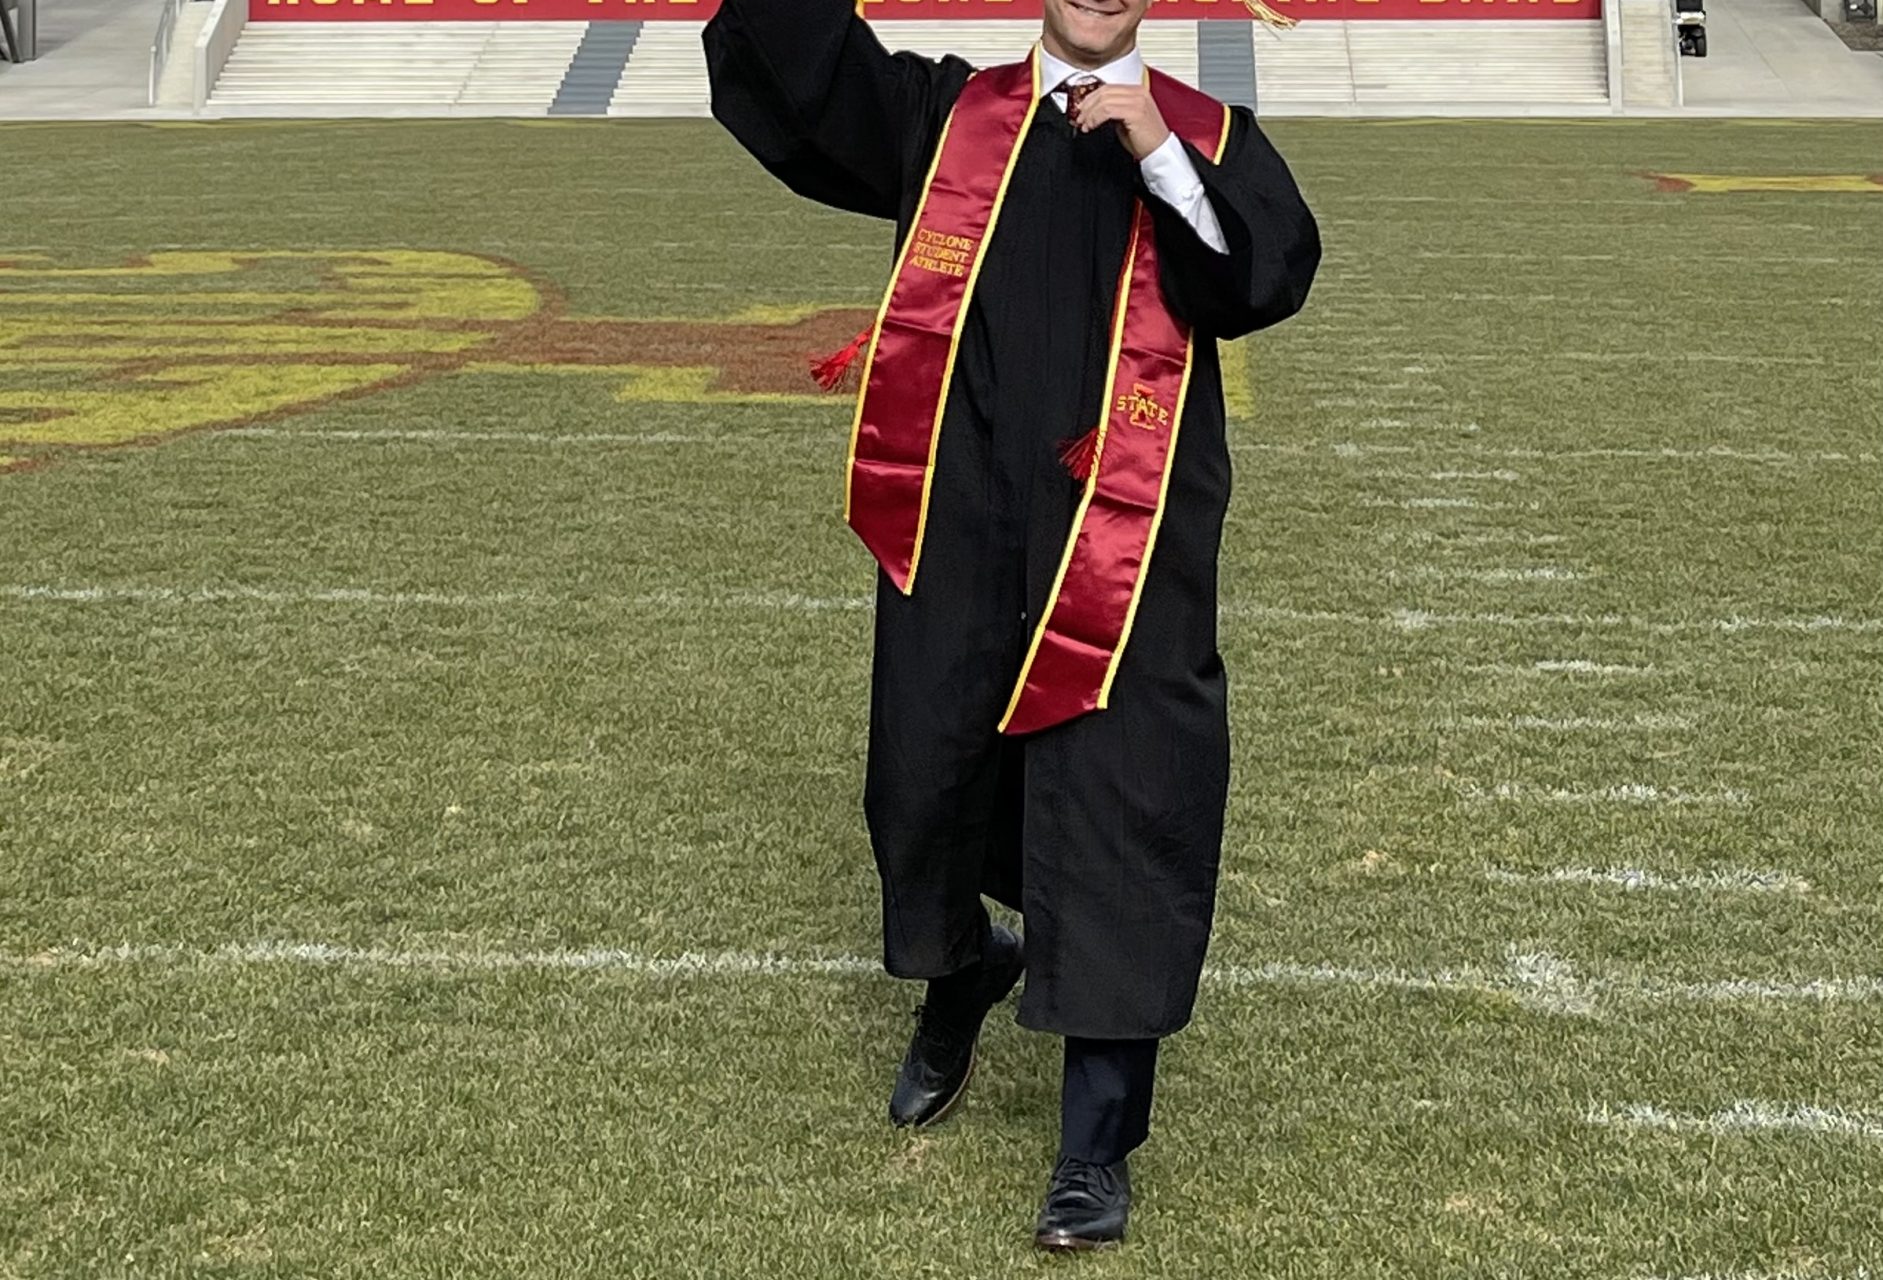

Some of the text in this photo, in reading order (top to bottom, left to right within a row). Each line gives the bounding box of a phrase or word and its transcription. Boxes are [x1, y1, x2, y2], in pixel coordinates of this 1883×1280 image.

[917, 228, 975, 251] CYCLONE
[913, 241, 969, 263] STUDENT
[908, 255, 966, 277] ATHLETE
[1115, 394, 1169, 426] STATE
